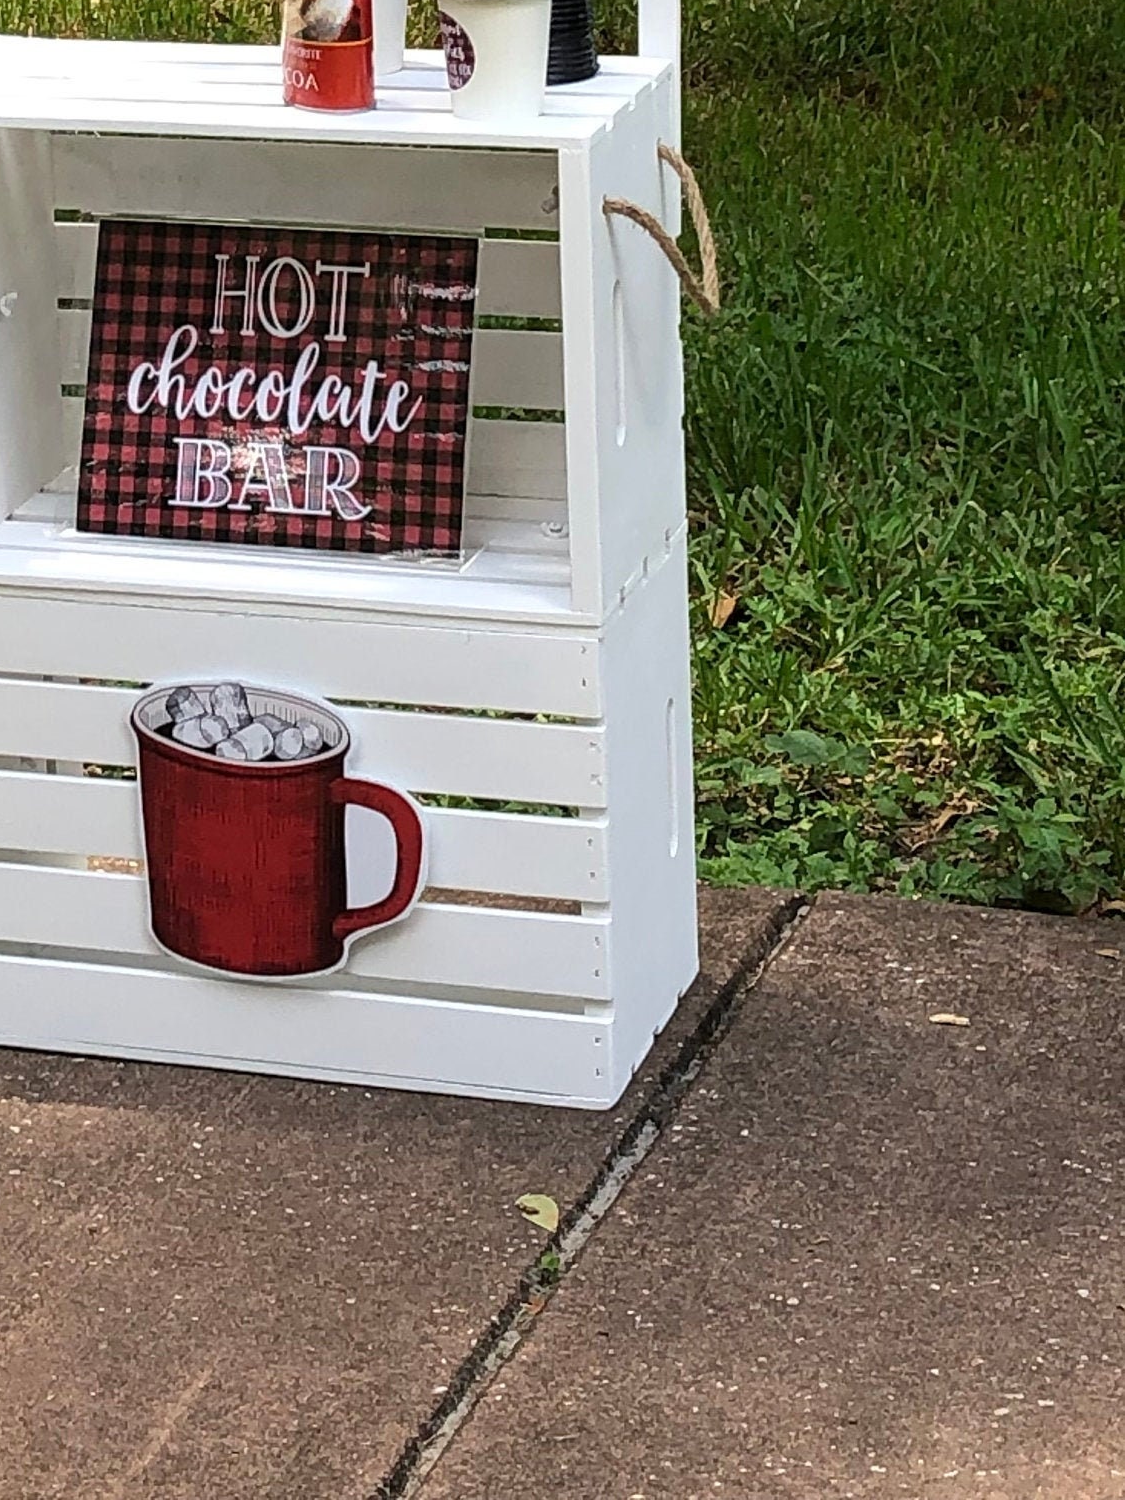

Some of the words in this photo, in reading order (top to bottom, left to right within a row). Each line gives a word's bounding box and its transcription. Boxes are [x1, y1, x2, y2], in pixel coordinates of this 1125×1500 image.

[209, 253, 371, 342] HOT
[126, 324, 423, 444] chocolate
[168, 436, 373, 522] BAR
